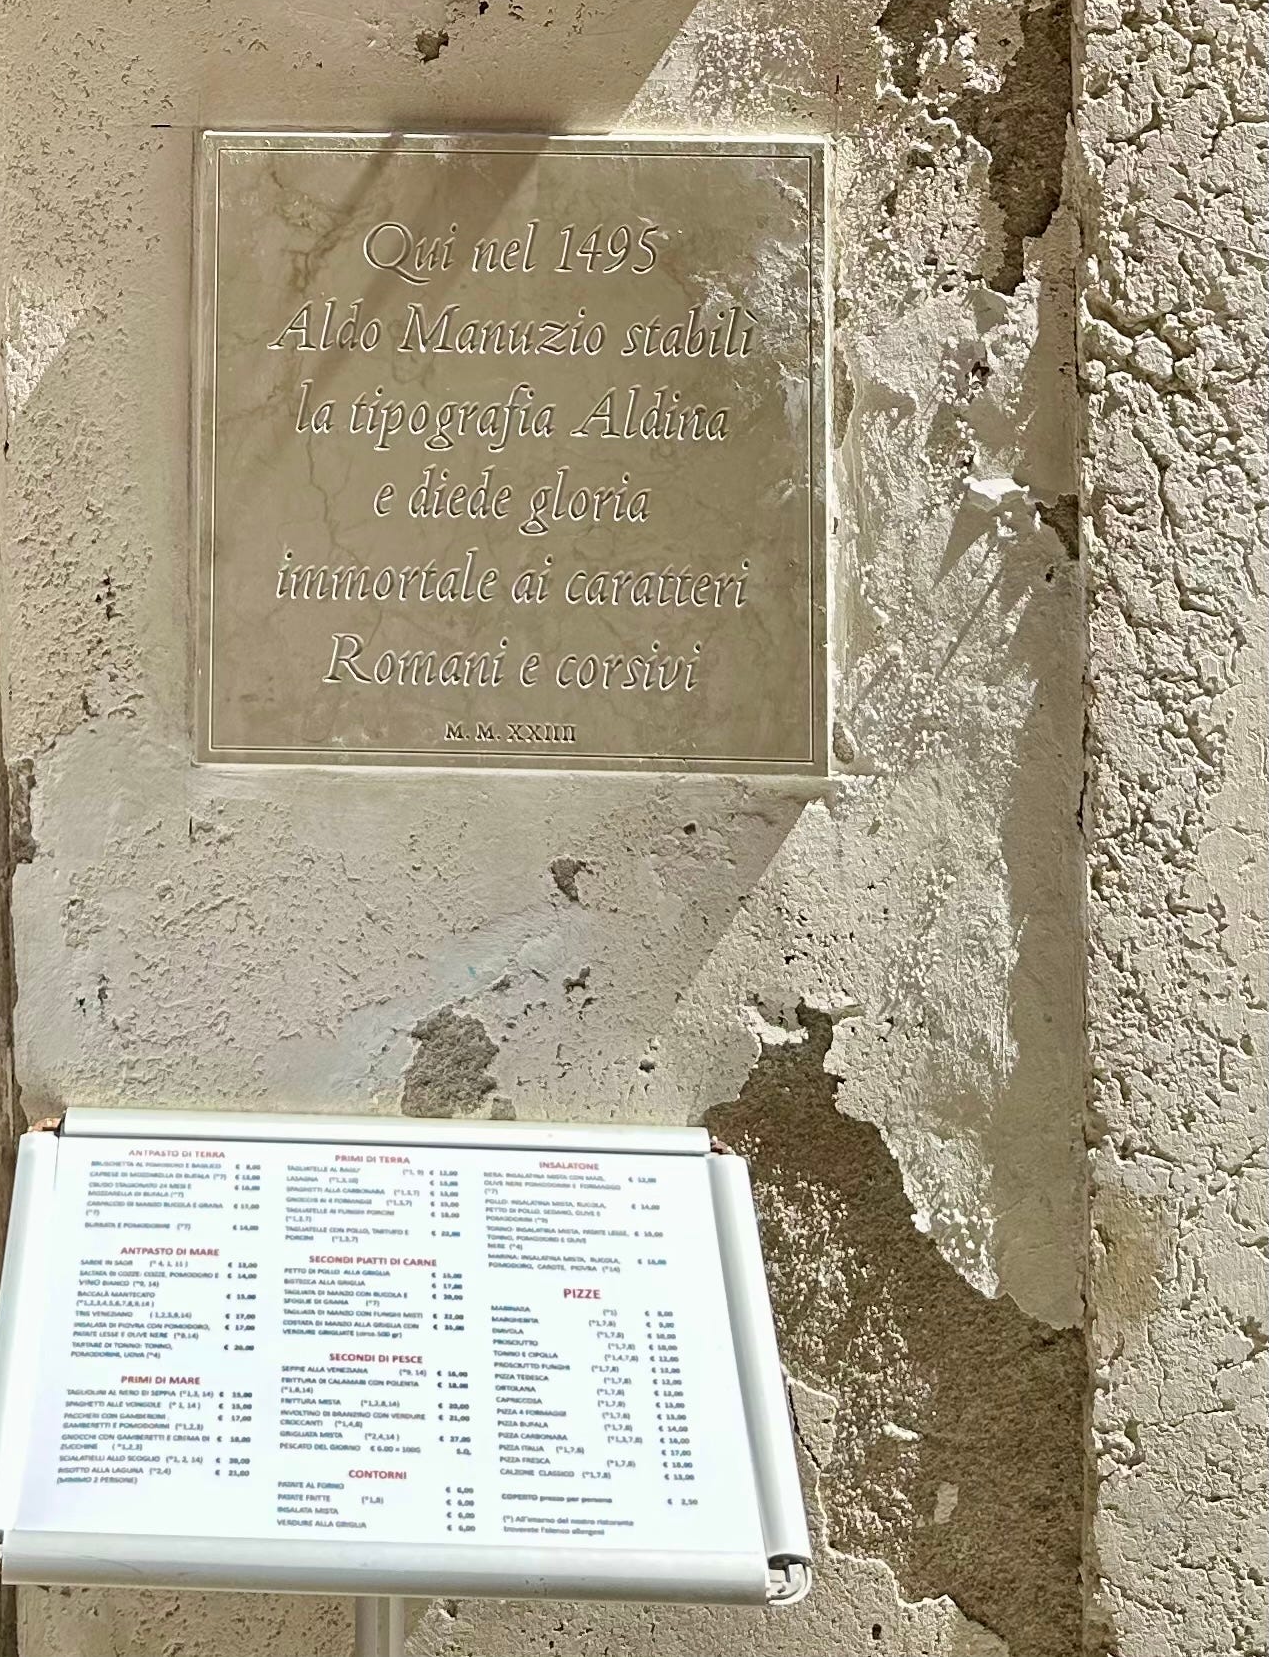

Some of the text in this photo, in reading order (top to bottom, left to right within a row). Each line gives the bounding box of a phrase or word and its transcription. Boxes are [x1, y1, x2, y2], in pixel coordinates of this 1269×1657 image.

[363, 220, 660, 284] Qui nel 1495
[268, 297, 760, 359] Aldo Manuzio stabilì
[296, 379, 729, 453] la tipografia Aldina
[373, 464, 651, 536] e diede gloria
[276, 548, 751, 608] immortale ai caratteri
[325, 633, 701, 692] Romani e corsivi
[379, 1156, 410, 1164] TERRA
[539, 1162, 599, 1170] INSALATONE
[176, 1248, 187, 1256] DI
[189, 1248, 219, 1257] MARE
[309, 1255, 437, 1267] SECONDI PIATTI DI CARNE
[563, 1288, 601, 1300] PIZZE
[492, 1338, 539, 1347] PROSCIUTTO
[329, 1353, 423, 1364] SECONDI DI PESCE
[494, 1361, 541, 1370] PROSCIUTTO
[121, 1375, 200, 1385] PRIMI DI MARE
[495, 1385, 537, 1393] ORTOLANA
[281, 1397, 317, 1405] FRITTURA
[280, 1442, 312, 1450] PESCATO
[348, 1469, 407, 1480] CONTORNI
[500, 1468, 535, 1476] CALZONE
[278, 1481, 304, 1489] PATATE
[277, 1493, 330, 1502] PATATE FRITTE
[501, 1493, 539, 1501] COPERTO
